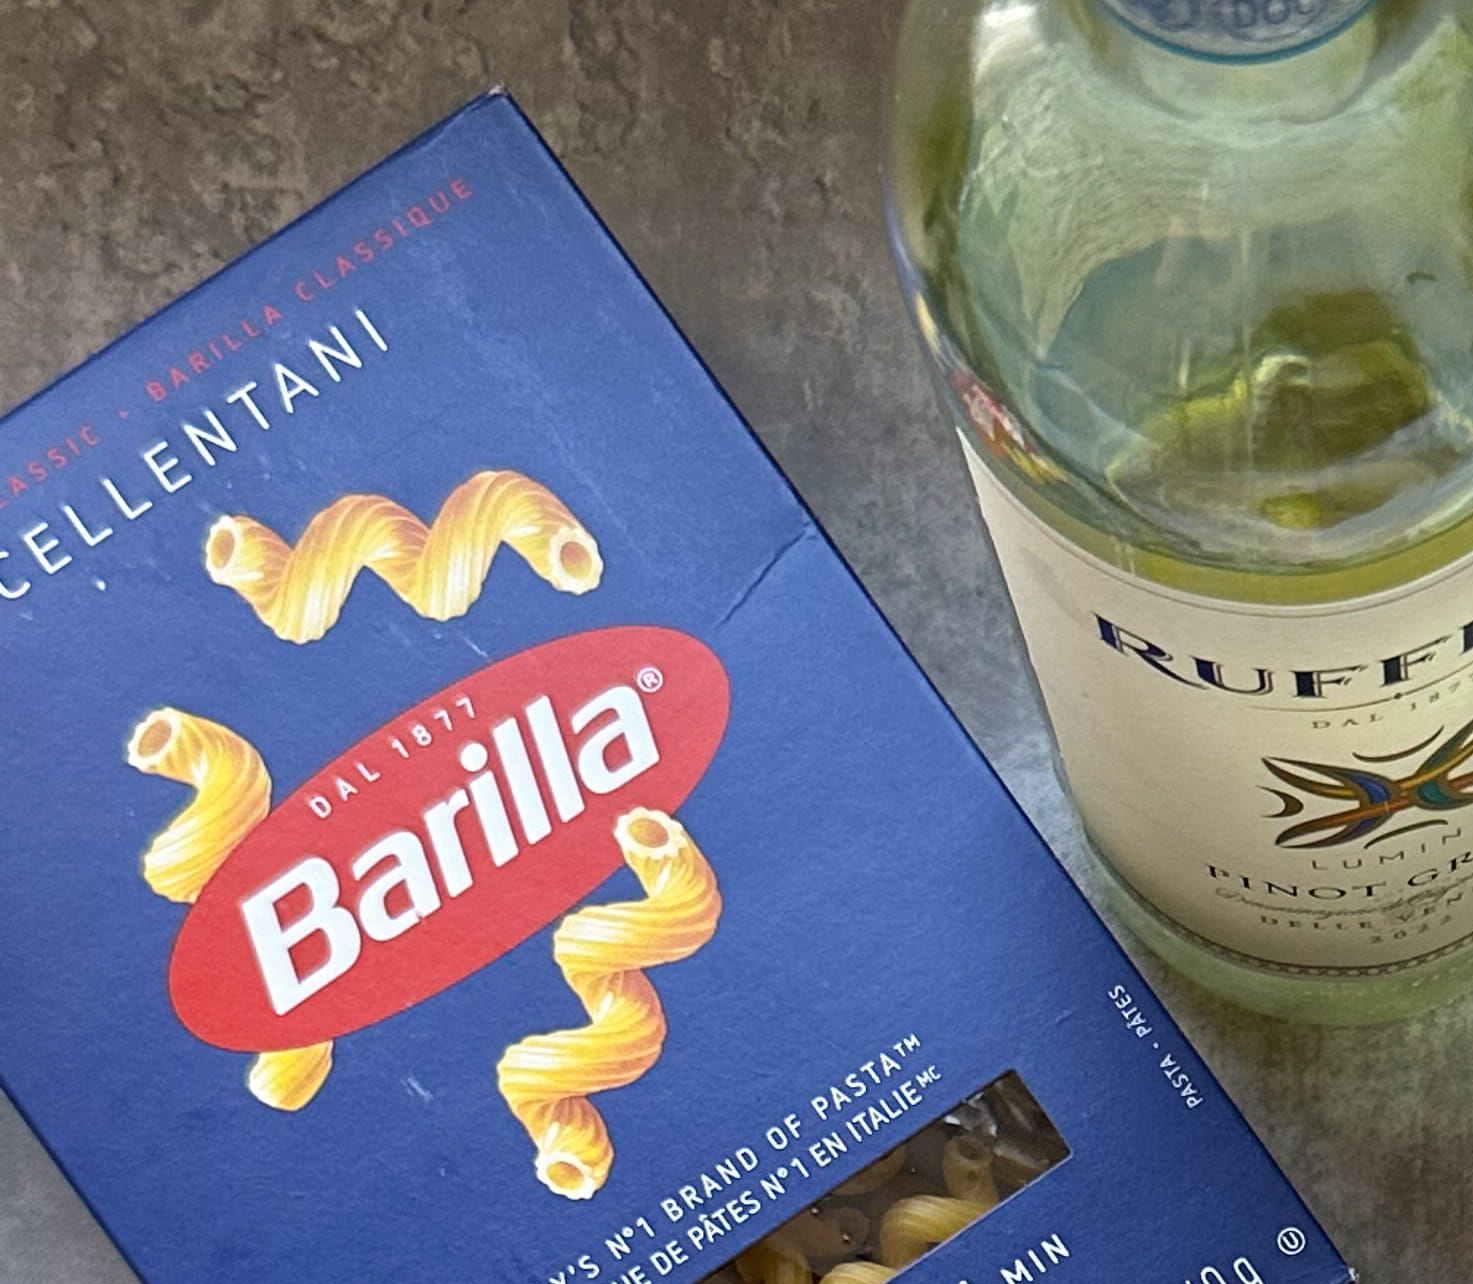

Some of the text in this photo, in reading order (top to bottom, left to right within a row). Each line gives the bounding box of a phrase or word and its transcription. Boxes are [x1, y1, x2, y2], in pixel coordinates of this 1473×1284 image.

[146, 304, 282, 402] BARILLA
[293, 178, 472, 302] CLASSIQUE
[310, 696, 478, 818] DAL 1877
[1311, 711, 1385, 730] DAL
[1205, 861, 1387, 900] PINOT
[1108, 983, 1204, 1109] PASTA PÂTES
[649, 1241, 689, 1277] DE
[687, 1190, 762, 1251] PÂTES
[809, 1132, 848, 1168] EN
[660, 1149, 759, 1223] BRAND
[765, 1113, 802, 1151] OF
